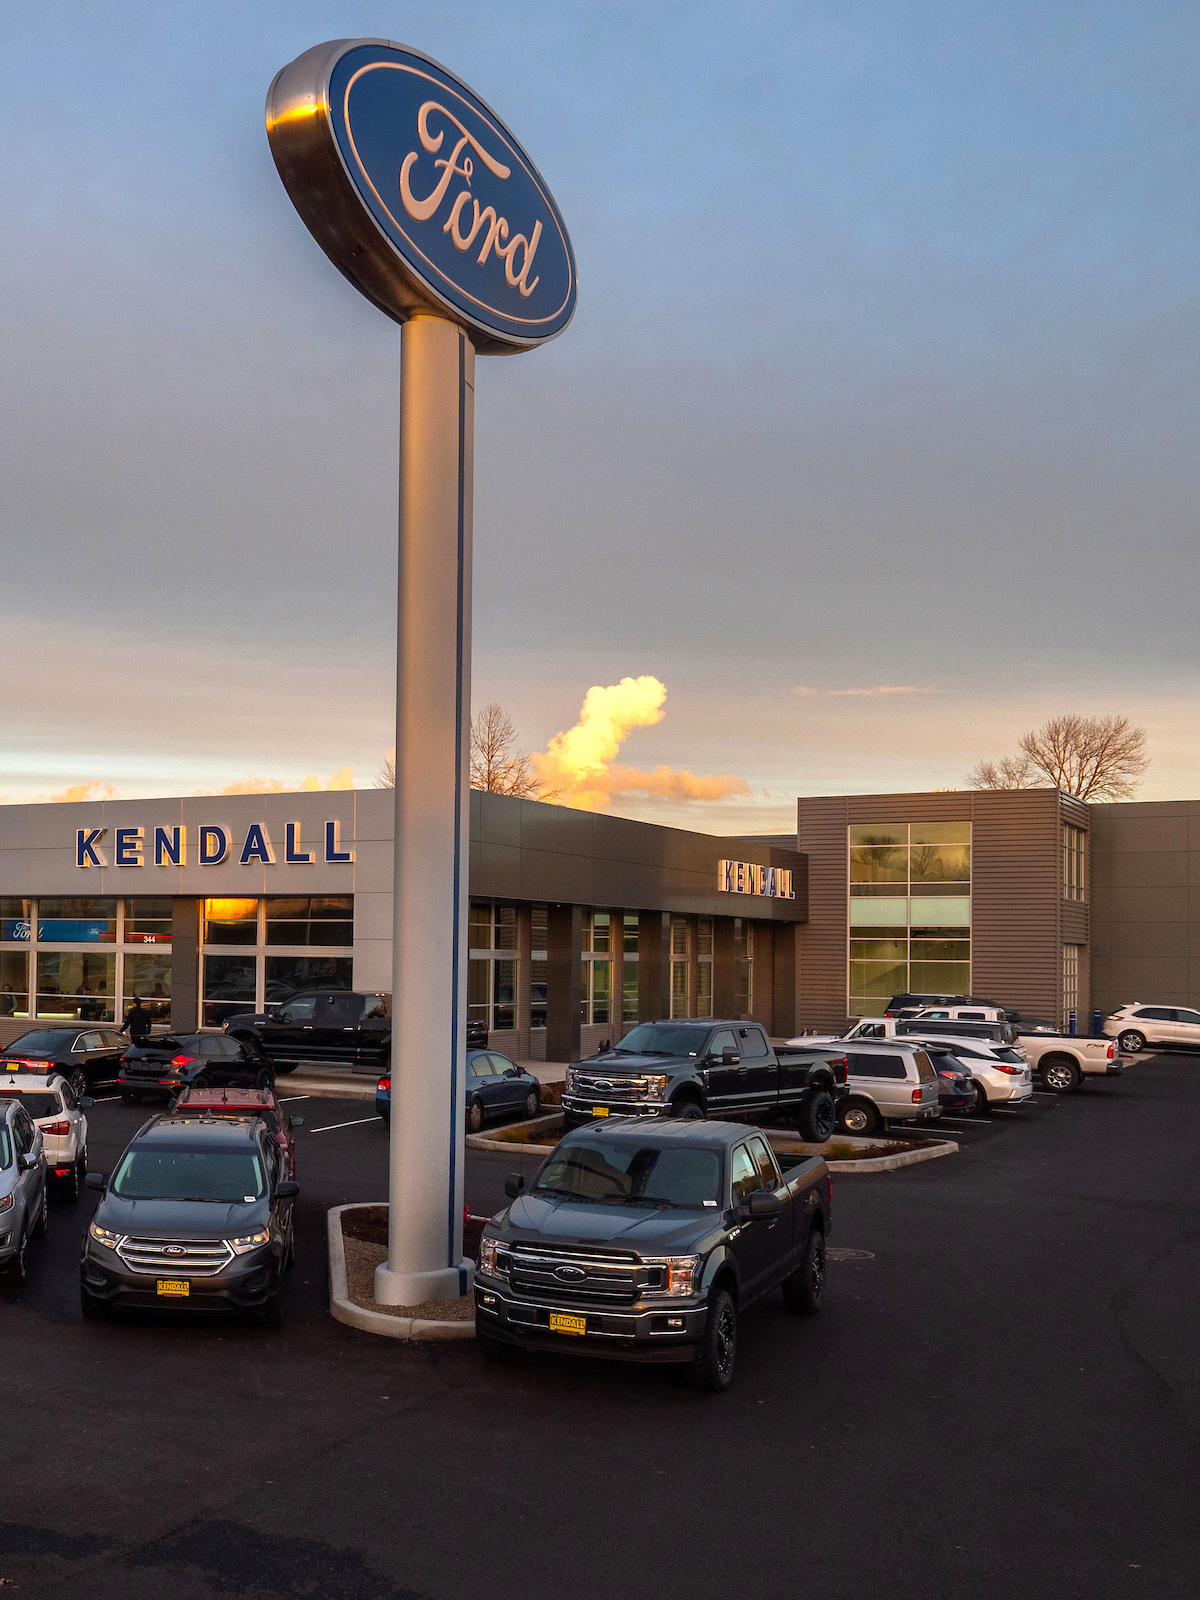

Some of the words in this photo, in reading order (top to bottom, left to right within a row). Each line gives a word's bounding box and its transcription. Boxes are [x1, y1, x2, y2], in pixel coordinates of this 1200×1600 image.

[400, 101, 543, 298] Ford
[75, 820, 356, 867] KENDALL
[718, 859, 796, 900] KENDALL
[158, 1282, 188, 1292] KENDALL
[551, 1314, 585, 1329] KENDALL
